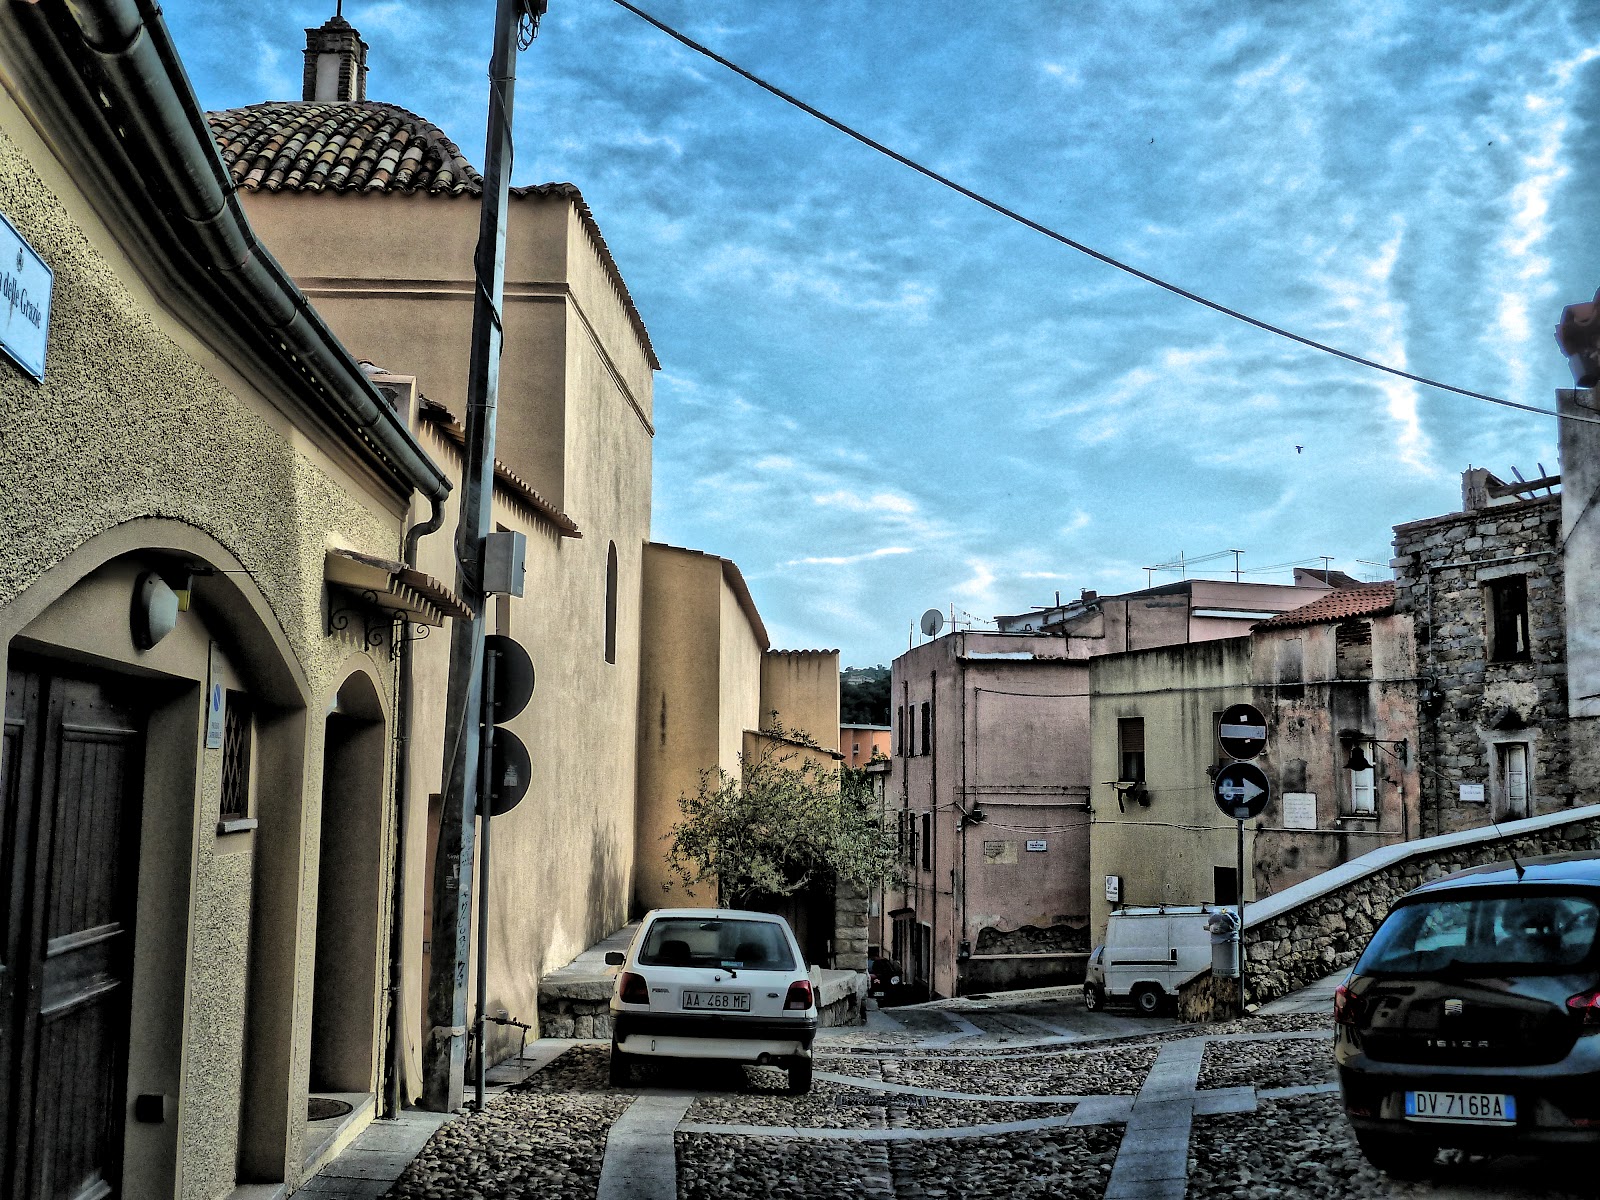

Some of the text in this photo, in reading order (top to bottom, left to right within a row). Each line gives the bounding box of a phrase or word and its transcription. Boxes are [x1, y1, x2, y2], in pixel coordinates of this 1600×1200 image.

[3, 271, 20, 308] delle
[20, 288, 42, 330] Grazie
[686, 993, 749, 1008] AA 468 MF
[1417, 1093, 1502, 1116] DV 716BA
